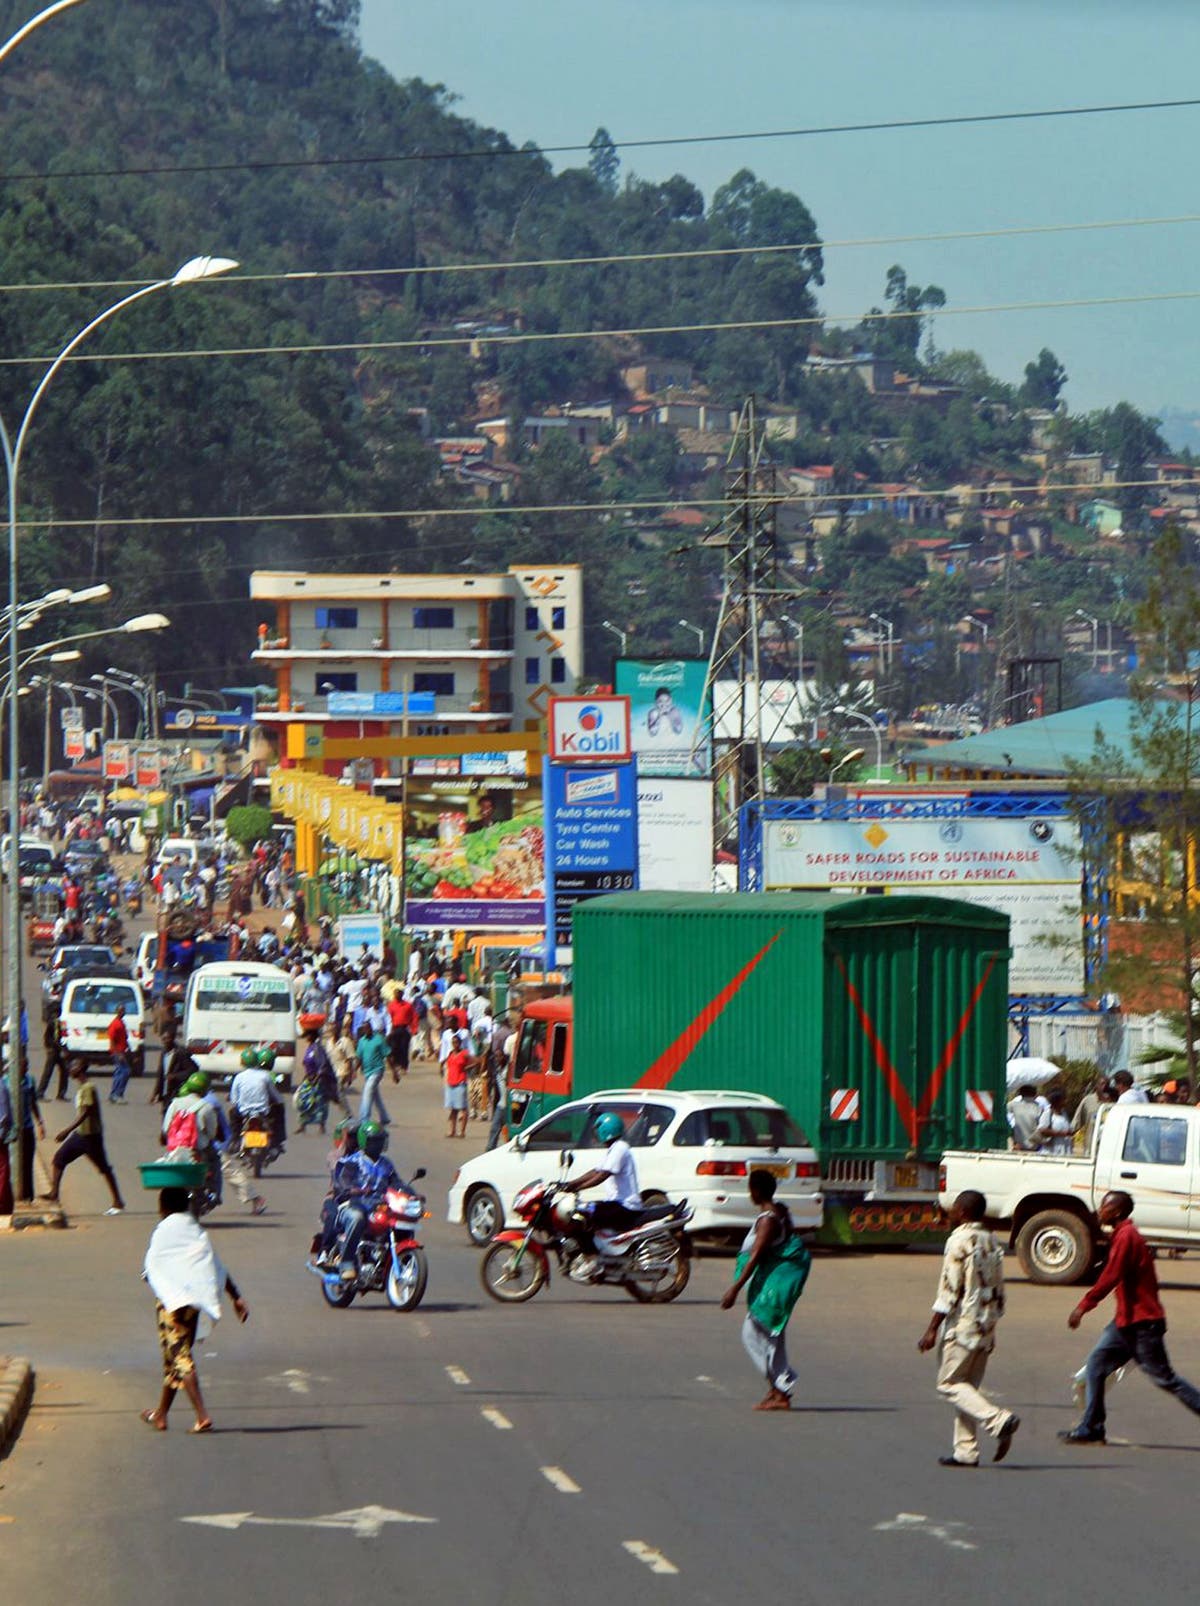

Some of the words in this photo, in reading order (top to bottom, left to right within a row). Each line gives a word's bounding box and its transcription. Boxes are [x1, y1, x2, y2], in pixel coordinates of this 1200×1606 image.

[561, 731, 620, 752] Kobil
[555, 807, 582, 818] Auto
[584, 807, 632, 818] Services
[556, 823, 579, 836] Tyre
[582, 823, 620, 834] Centre
[556, 839, 576, 849] Car
[580, 839, 610, 849] Wash
[556, 855, 572, 866] 24
[574, 855, 609, 865] Hours
[806, 852, 850, 865] SAFER
[855, 851, 905, 864] ROADS
[910, 851, 939, 863] FOR
[945, 850, 1041, 863] SUSTAINABLE
[828, 869, 934, 883] DEVELOPMENT
[938, 869, 959, 881] OF
[964, 868, 1018, 880] AFRICA
